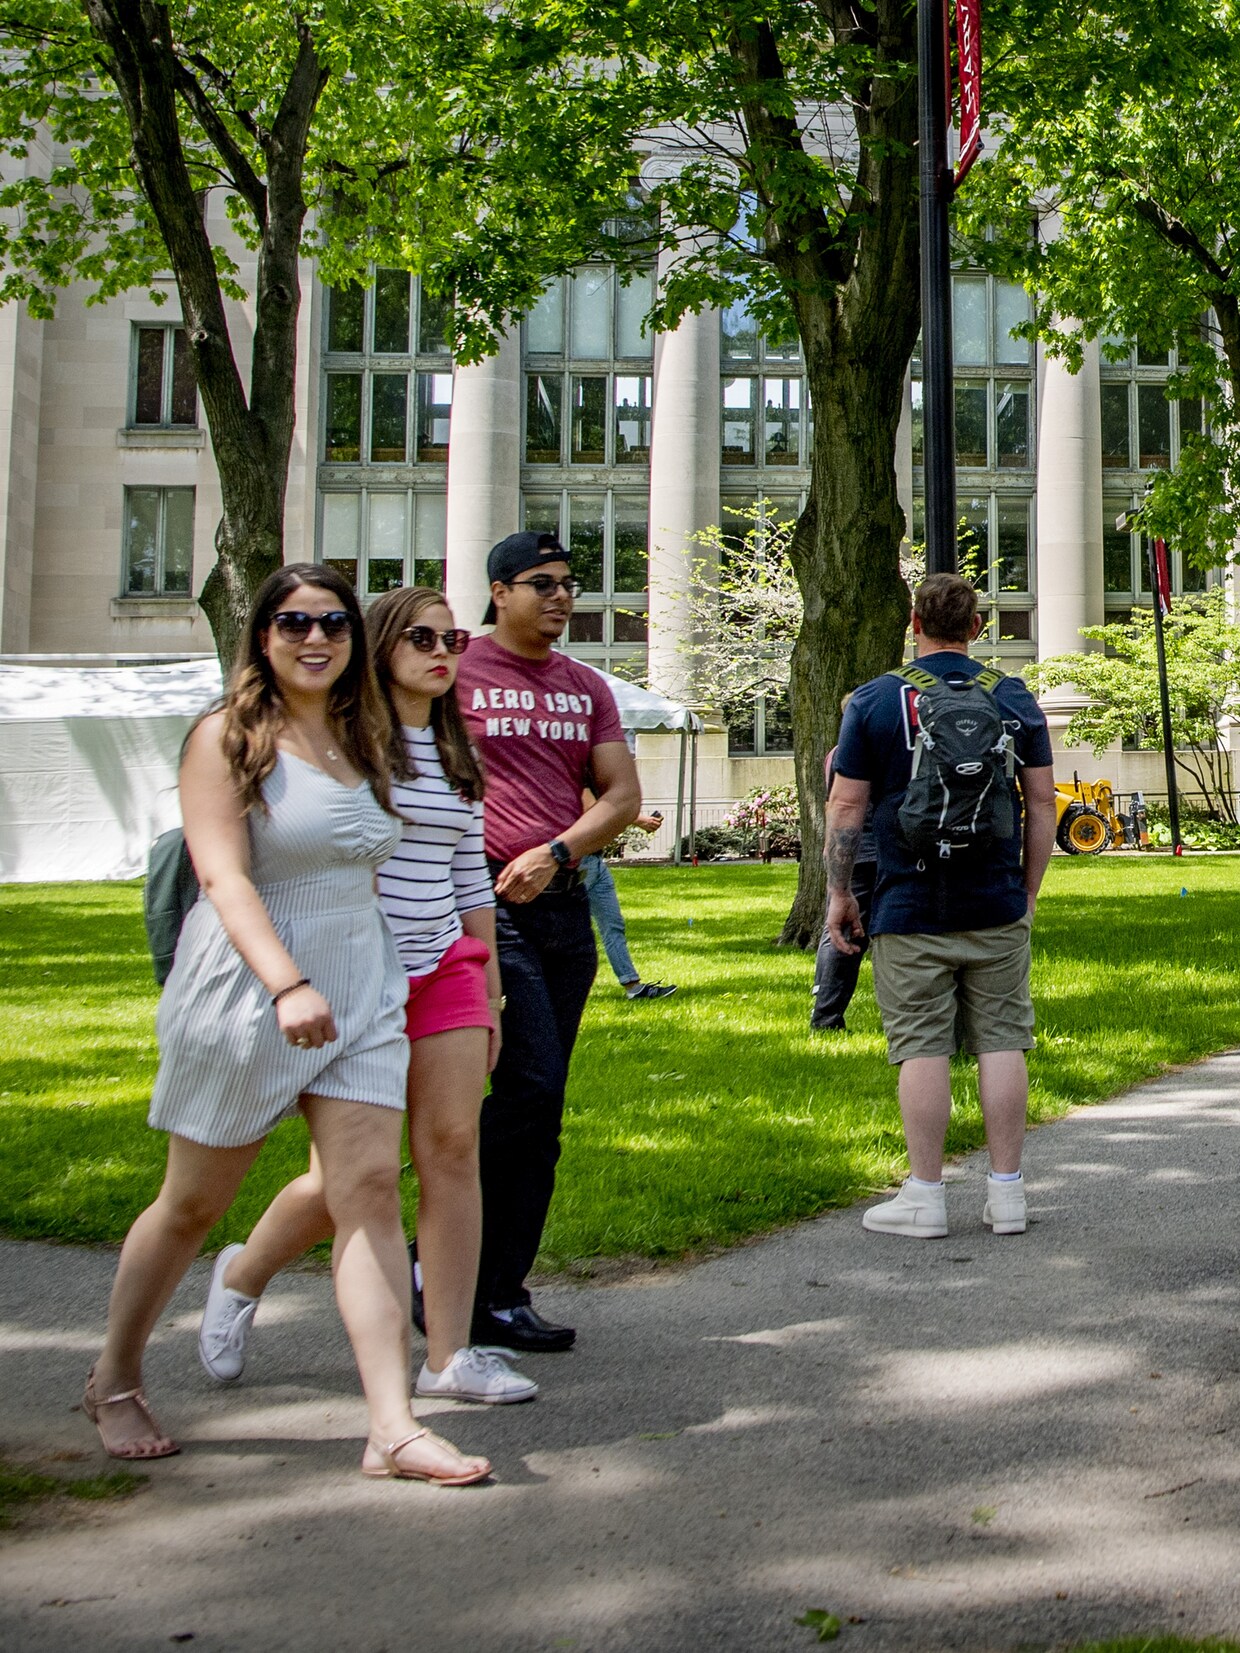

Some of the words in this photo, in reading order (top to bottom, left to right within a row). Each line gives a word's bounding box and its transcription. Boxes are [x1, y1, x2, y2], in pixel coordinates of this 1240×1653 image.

[471, 688, 536, 711] AERO
[543, 692, 593, 716] 1987
[486, 717, 532, 737] NEW
[537, 720, 589, 742] YORK
